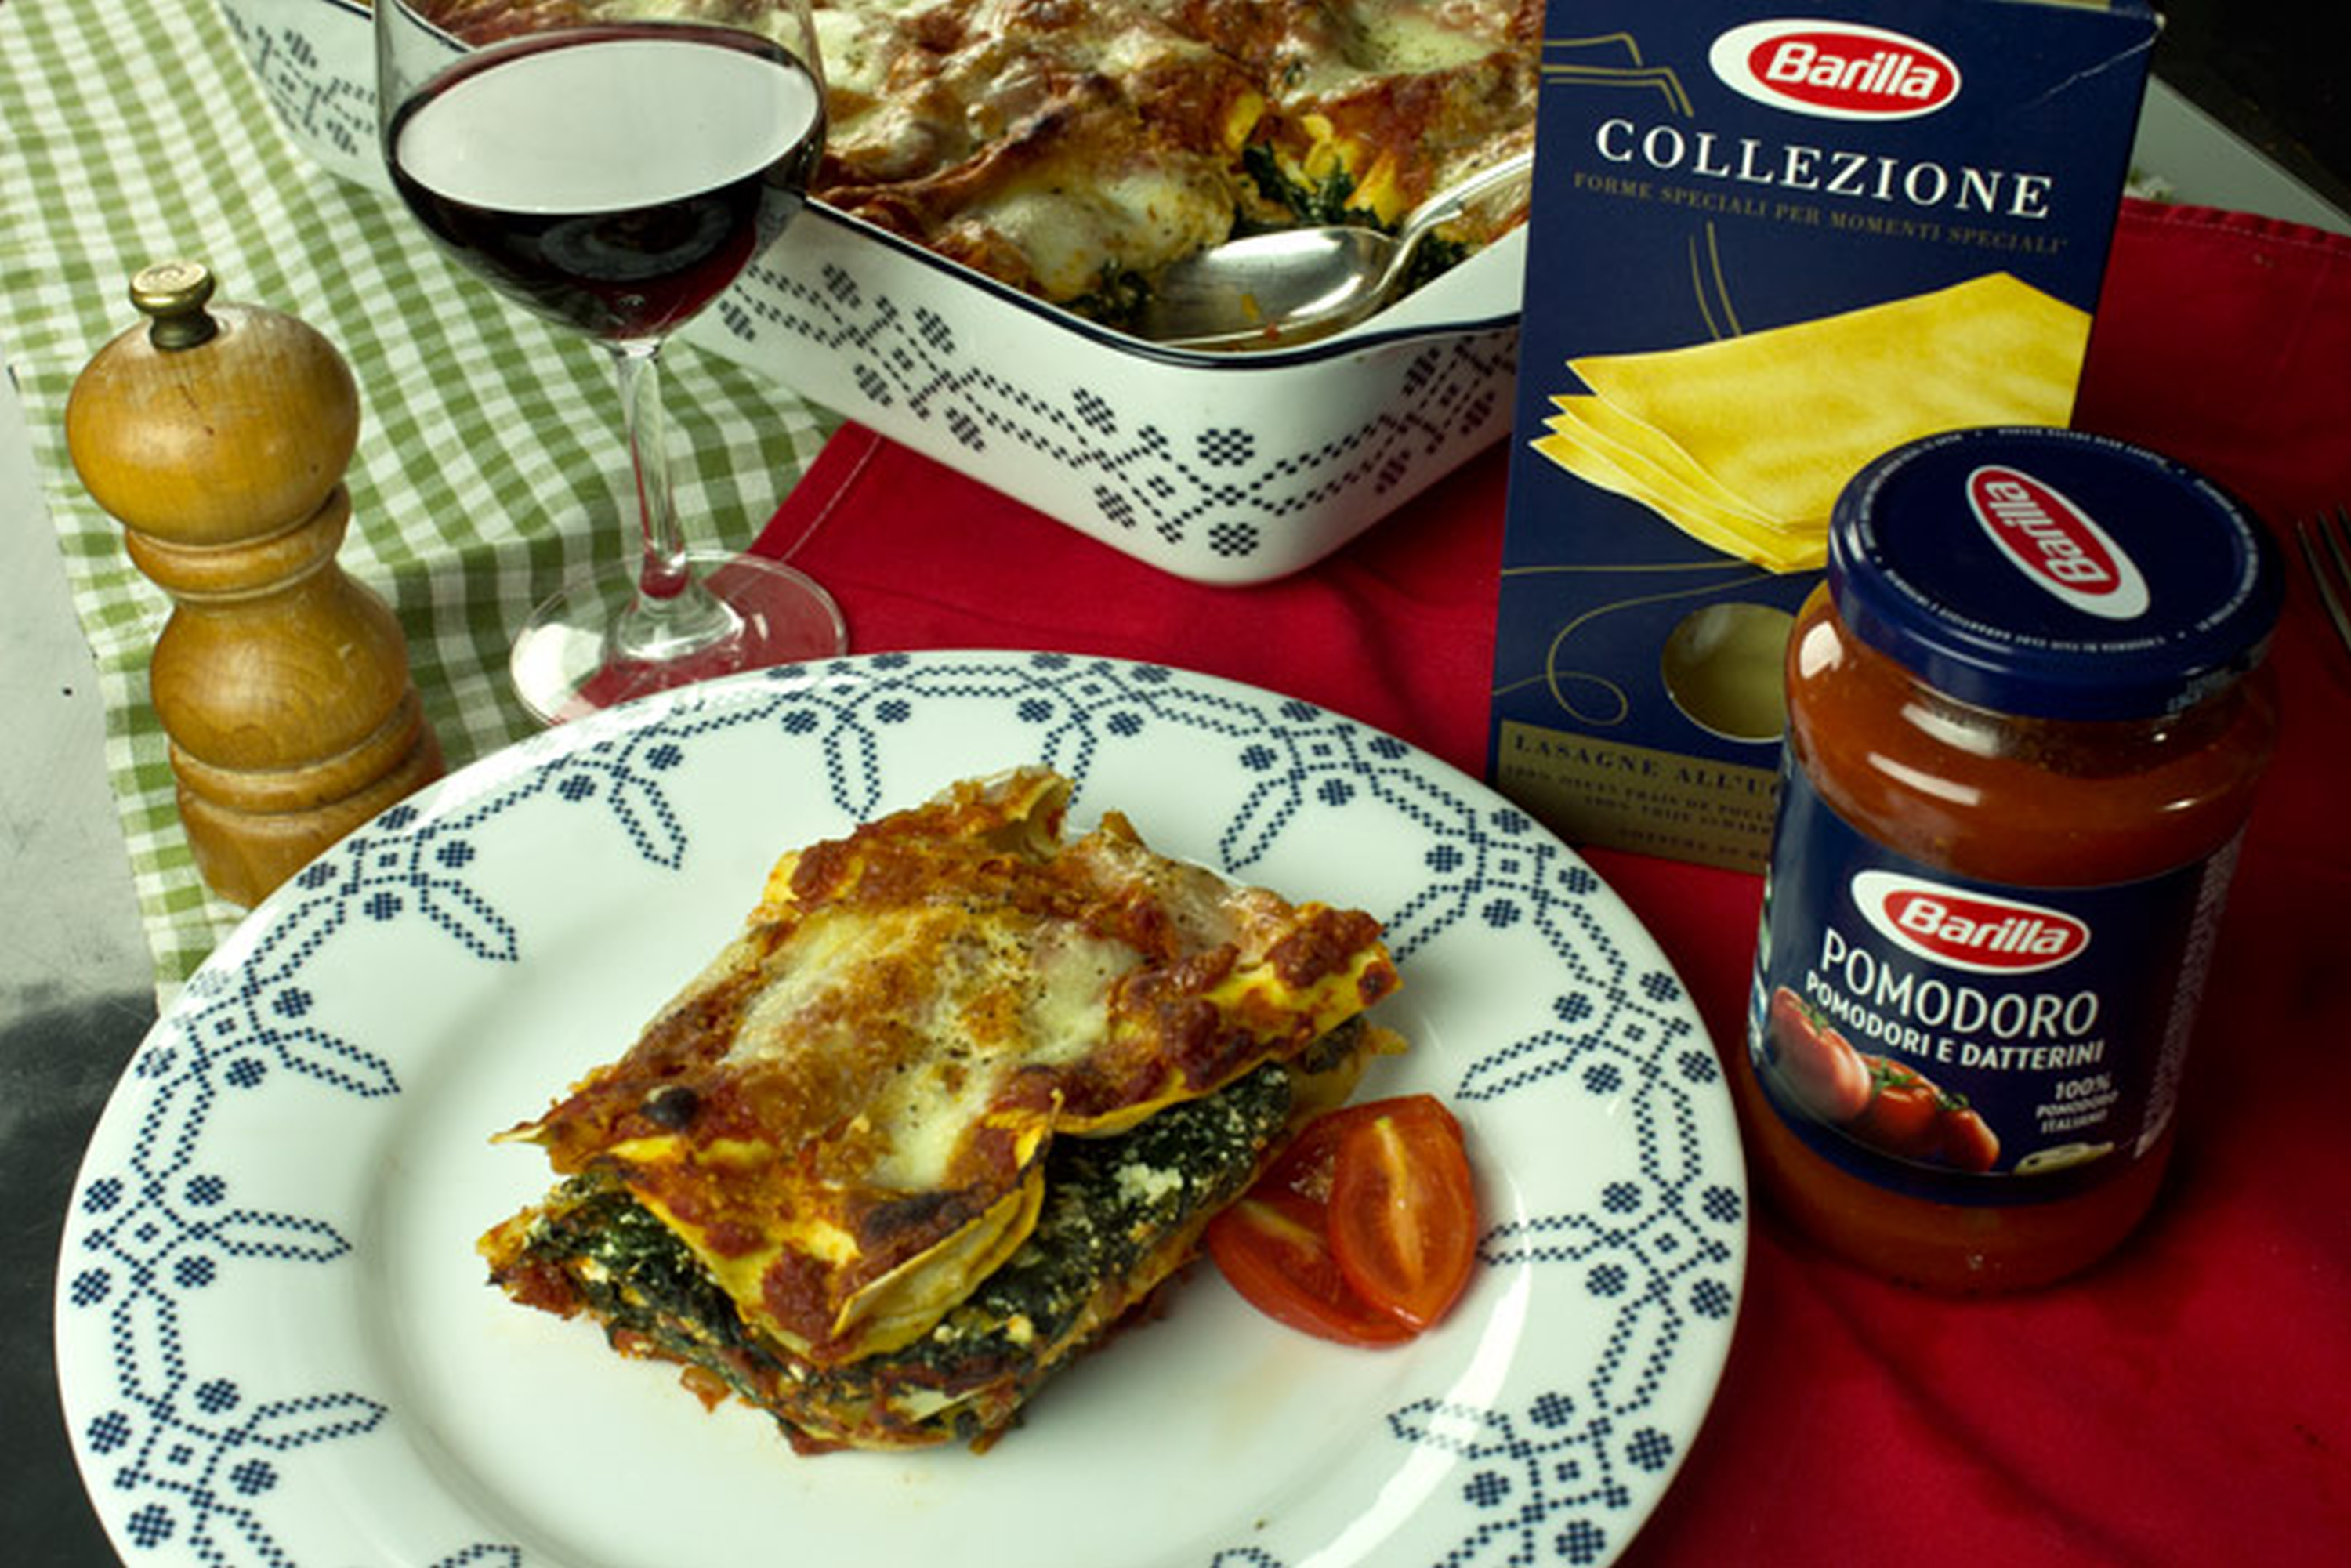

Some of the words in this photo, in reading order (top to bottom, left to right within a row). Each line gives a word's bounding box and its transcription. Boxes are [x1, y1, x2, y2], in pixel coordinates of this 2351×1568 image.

[1766, 42, 1940, 101] Barilla
[1596, 118, 2052, 219] COLLEZIONE
[1573, 171, 1653, 201] FORME
[1661, 185, 1767, 220] SPECIALI
[1775, 203, 1821, 227] PER
[1830, 210, 1940, 244] MOMENTI
[1984, 480, 2110, 583] Barilla
[1514, 733, 1661, 780] LASAGNE
[1897, 897, 2070, 955] Barilla
[1821, 927, 2099, 1039] POMODORO
[1806, 970, 1930, 1056] POMODORI
[1937, 1038, 1954, 1063] E
[1961, 1039, 2105, 1070] DATTERINI
[2054, 1073, 2112, 1101] 100%
